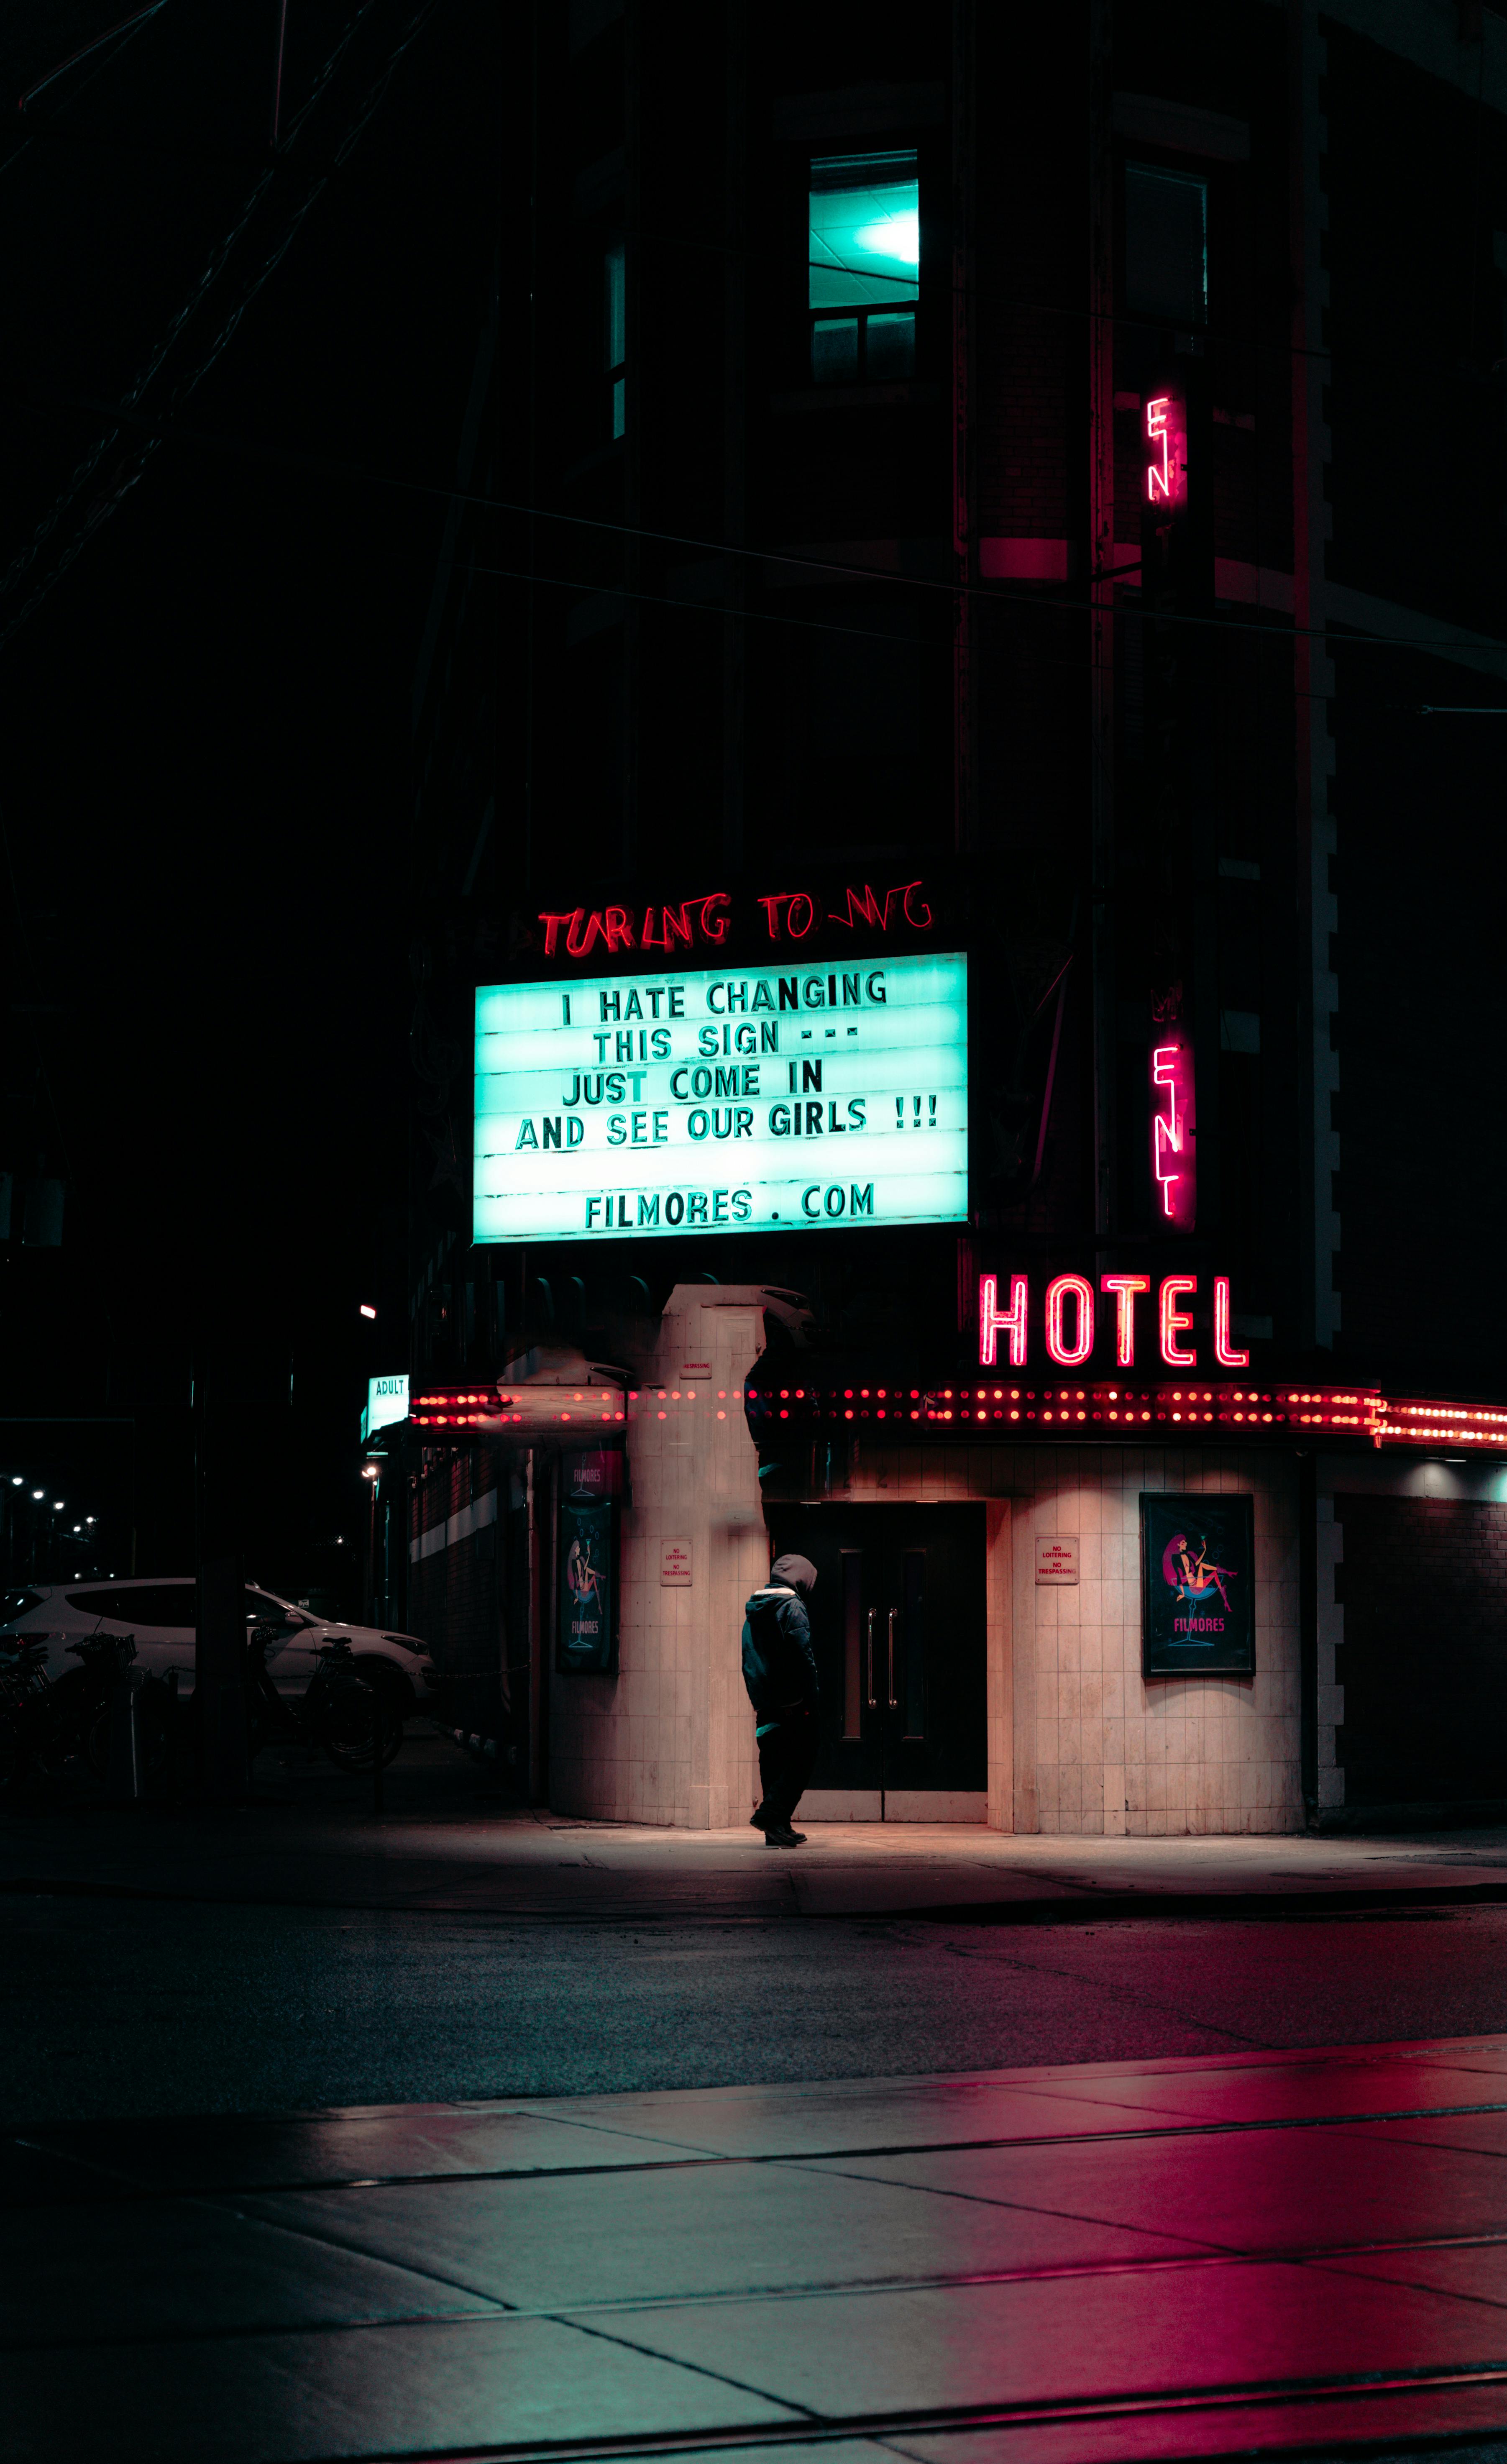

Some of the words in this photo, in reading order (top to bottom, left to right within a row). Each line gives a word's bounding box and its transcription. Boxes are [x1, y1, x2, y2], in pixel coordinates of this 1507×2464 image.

[563, 994, 570, 1026] I
[600, 986, 684, 1022] HATE
[706, 971, 886, 1014] CHANGING
[594, 1029, 671, 1062] THIS
[698, 1021, 779, 1058] SIGN
[563, 1071, 647, 1106] JUST
[670, 1065, 760, 1099] COME
[790, 1060, 822, 1093] IN
[515, 1116, 584, 1150] AND
[607, 1111, 669, 1145] SEE
[688, 1106, 753, 1141] OUR
[769, 1098, 867, 1137] GIRLS
[896, 1095, 937, 1128] !!!
[586, 1189, 752, 1228] FILMORES
[802, 1183, 874, 1218] COM
[979, 1273, 1250, 1367] HOTEL
[376, 1380, 403, 1395] ADULT
[574, 1469, 600, 1482] FILMORES
[572, 1621, 599, 1634] FILMORES
[1174, 1618, 1224, 1632] FILMORES
